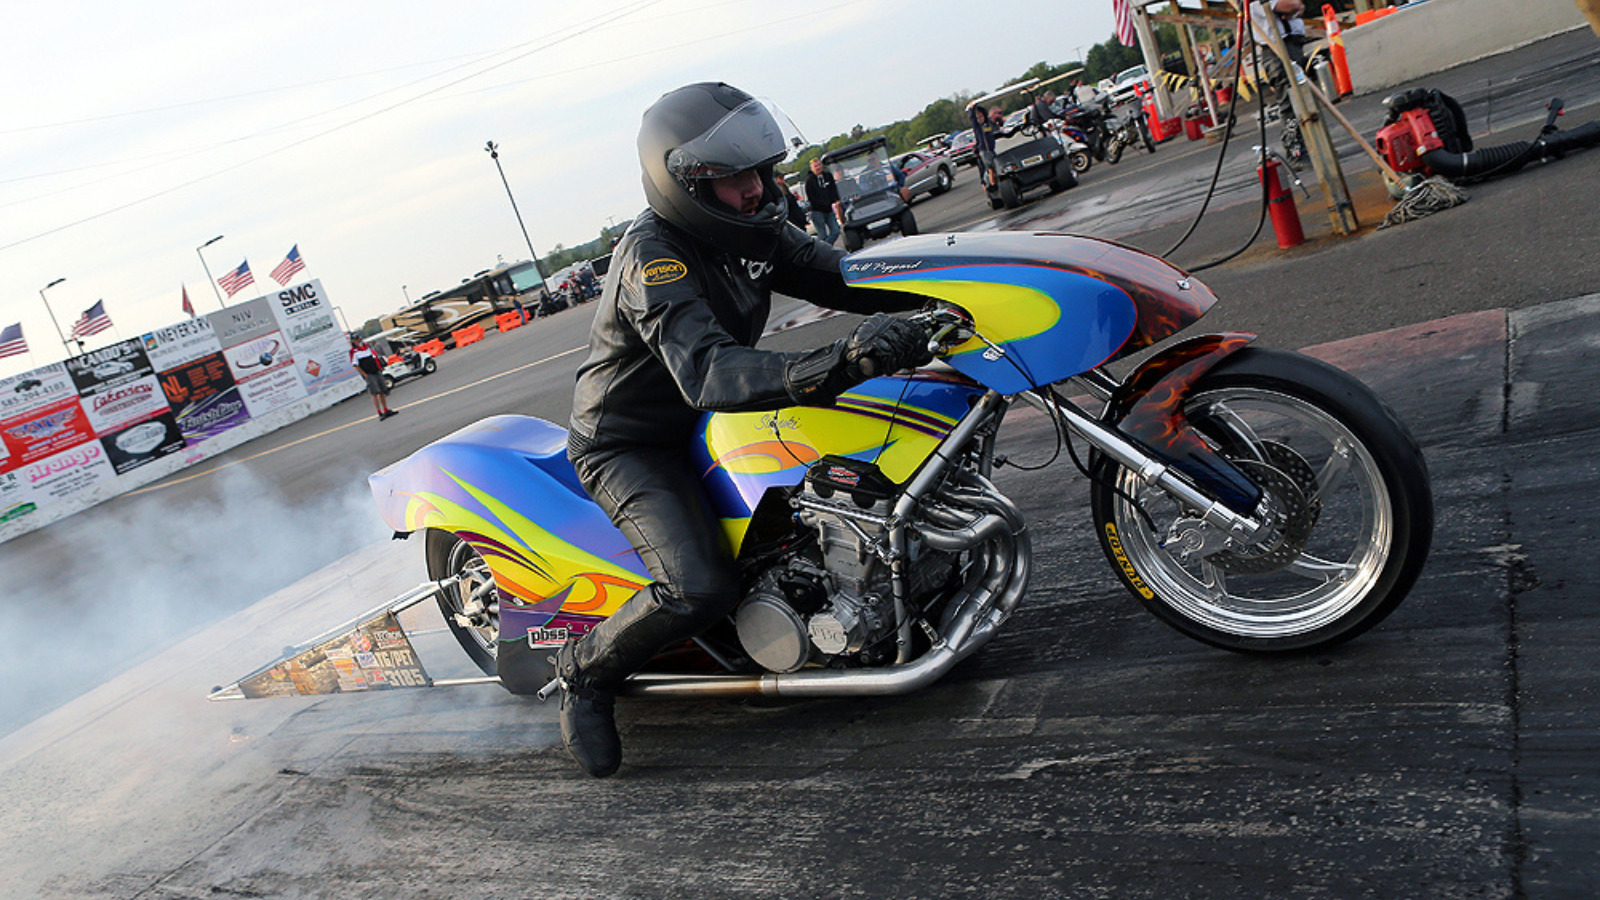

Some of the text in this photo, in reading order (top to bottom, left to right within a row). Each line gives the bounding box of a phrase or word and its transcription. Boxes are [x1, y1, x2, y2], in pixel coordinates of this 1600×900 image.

[278, 283, 316, 306] SMC
[157, 316, 211, 344] MEYER'S RV
[161, 375, 187, 396] NL
[93, 383, 154, 412] Lakeview
[24, 445, 100, 483] Arango
[1106, 526, 1147, 590] DUNLOP
[531, 626, 566, 644] pbss
[374, 649, 414, 668] TG/PET
[384, 668, 427, 686] 3185
